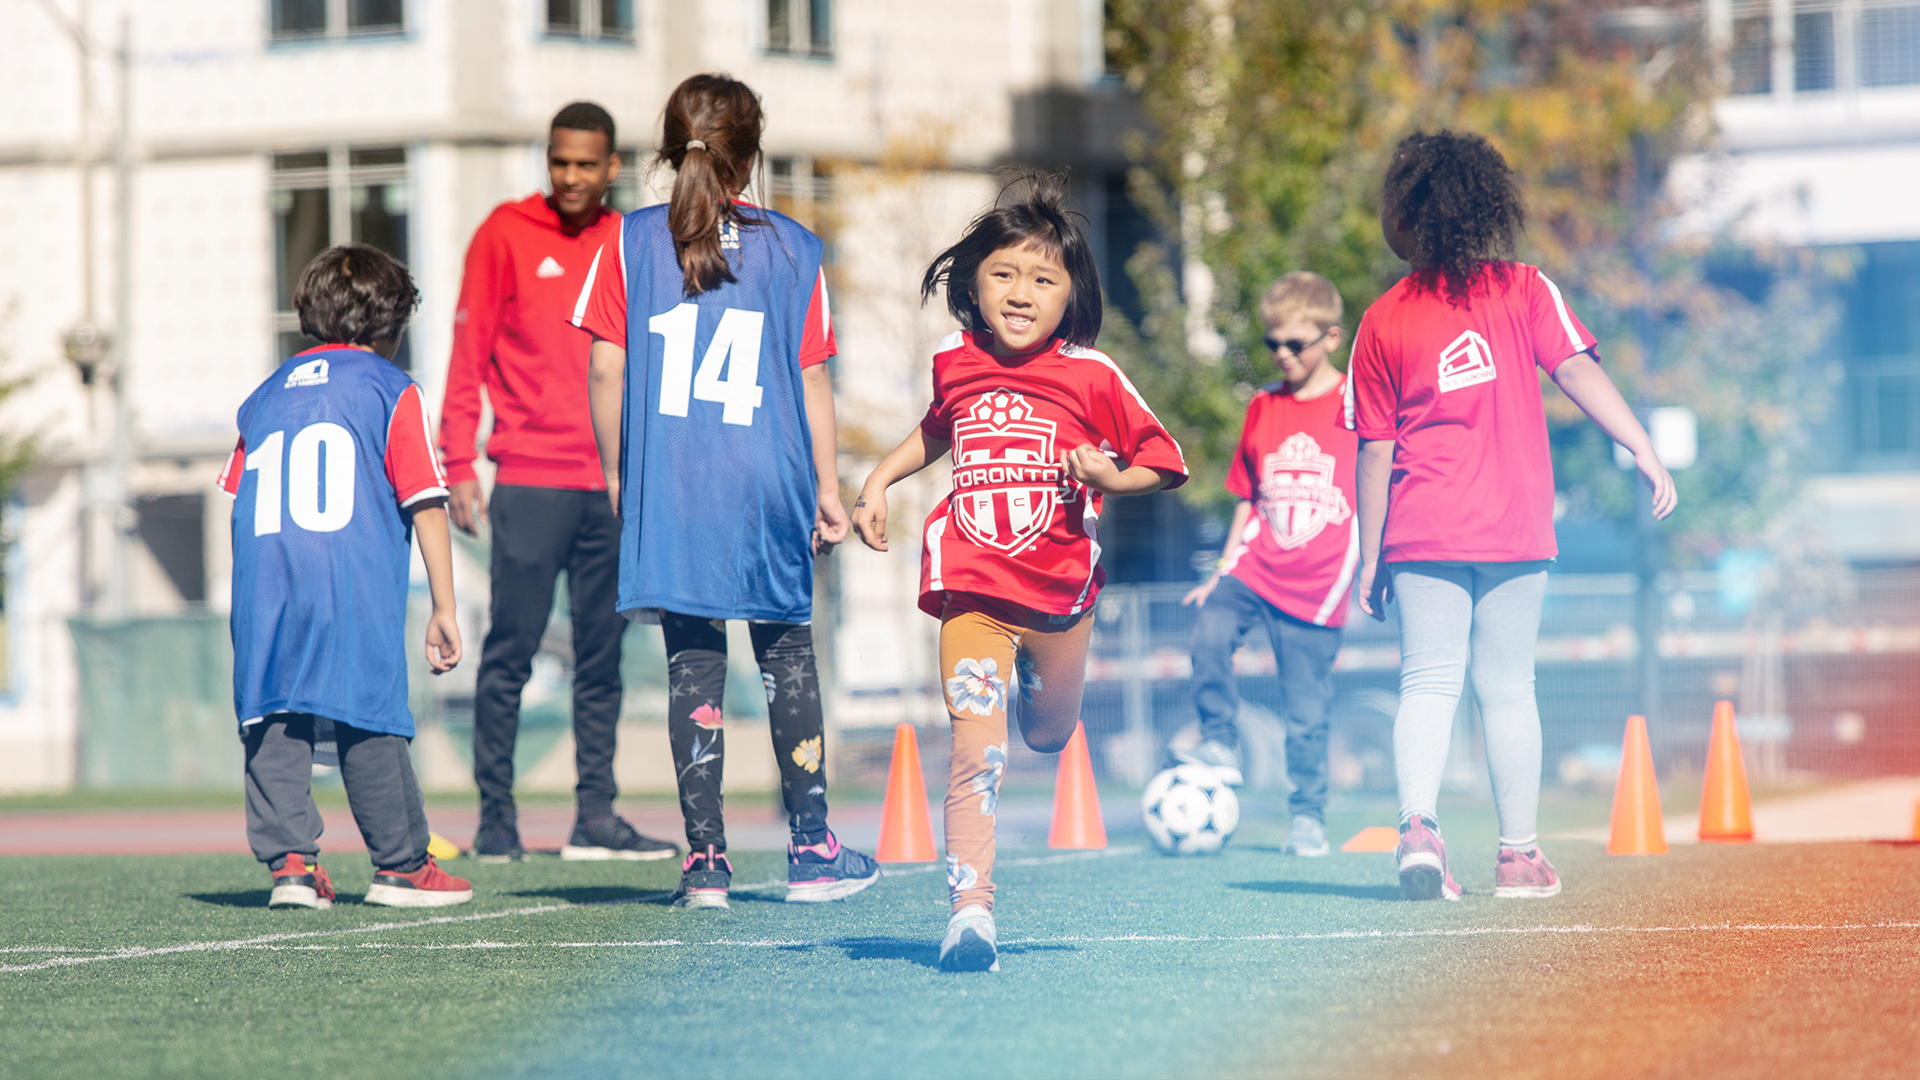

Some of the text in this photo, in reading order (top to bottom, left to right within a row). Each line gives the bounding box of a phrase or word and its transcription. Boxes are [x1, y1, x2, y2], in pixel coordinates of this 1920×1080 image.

[649, 302, 764, 427] 14
[245, 422, 356, 537] 10
[953, 466, 1059, 490] TORONTO
[979, 497, 1025, 510] F C
